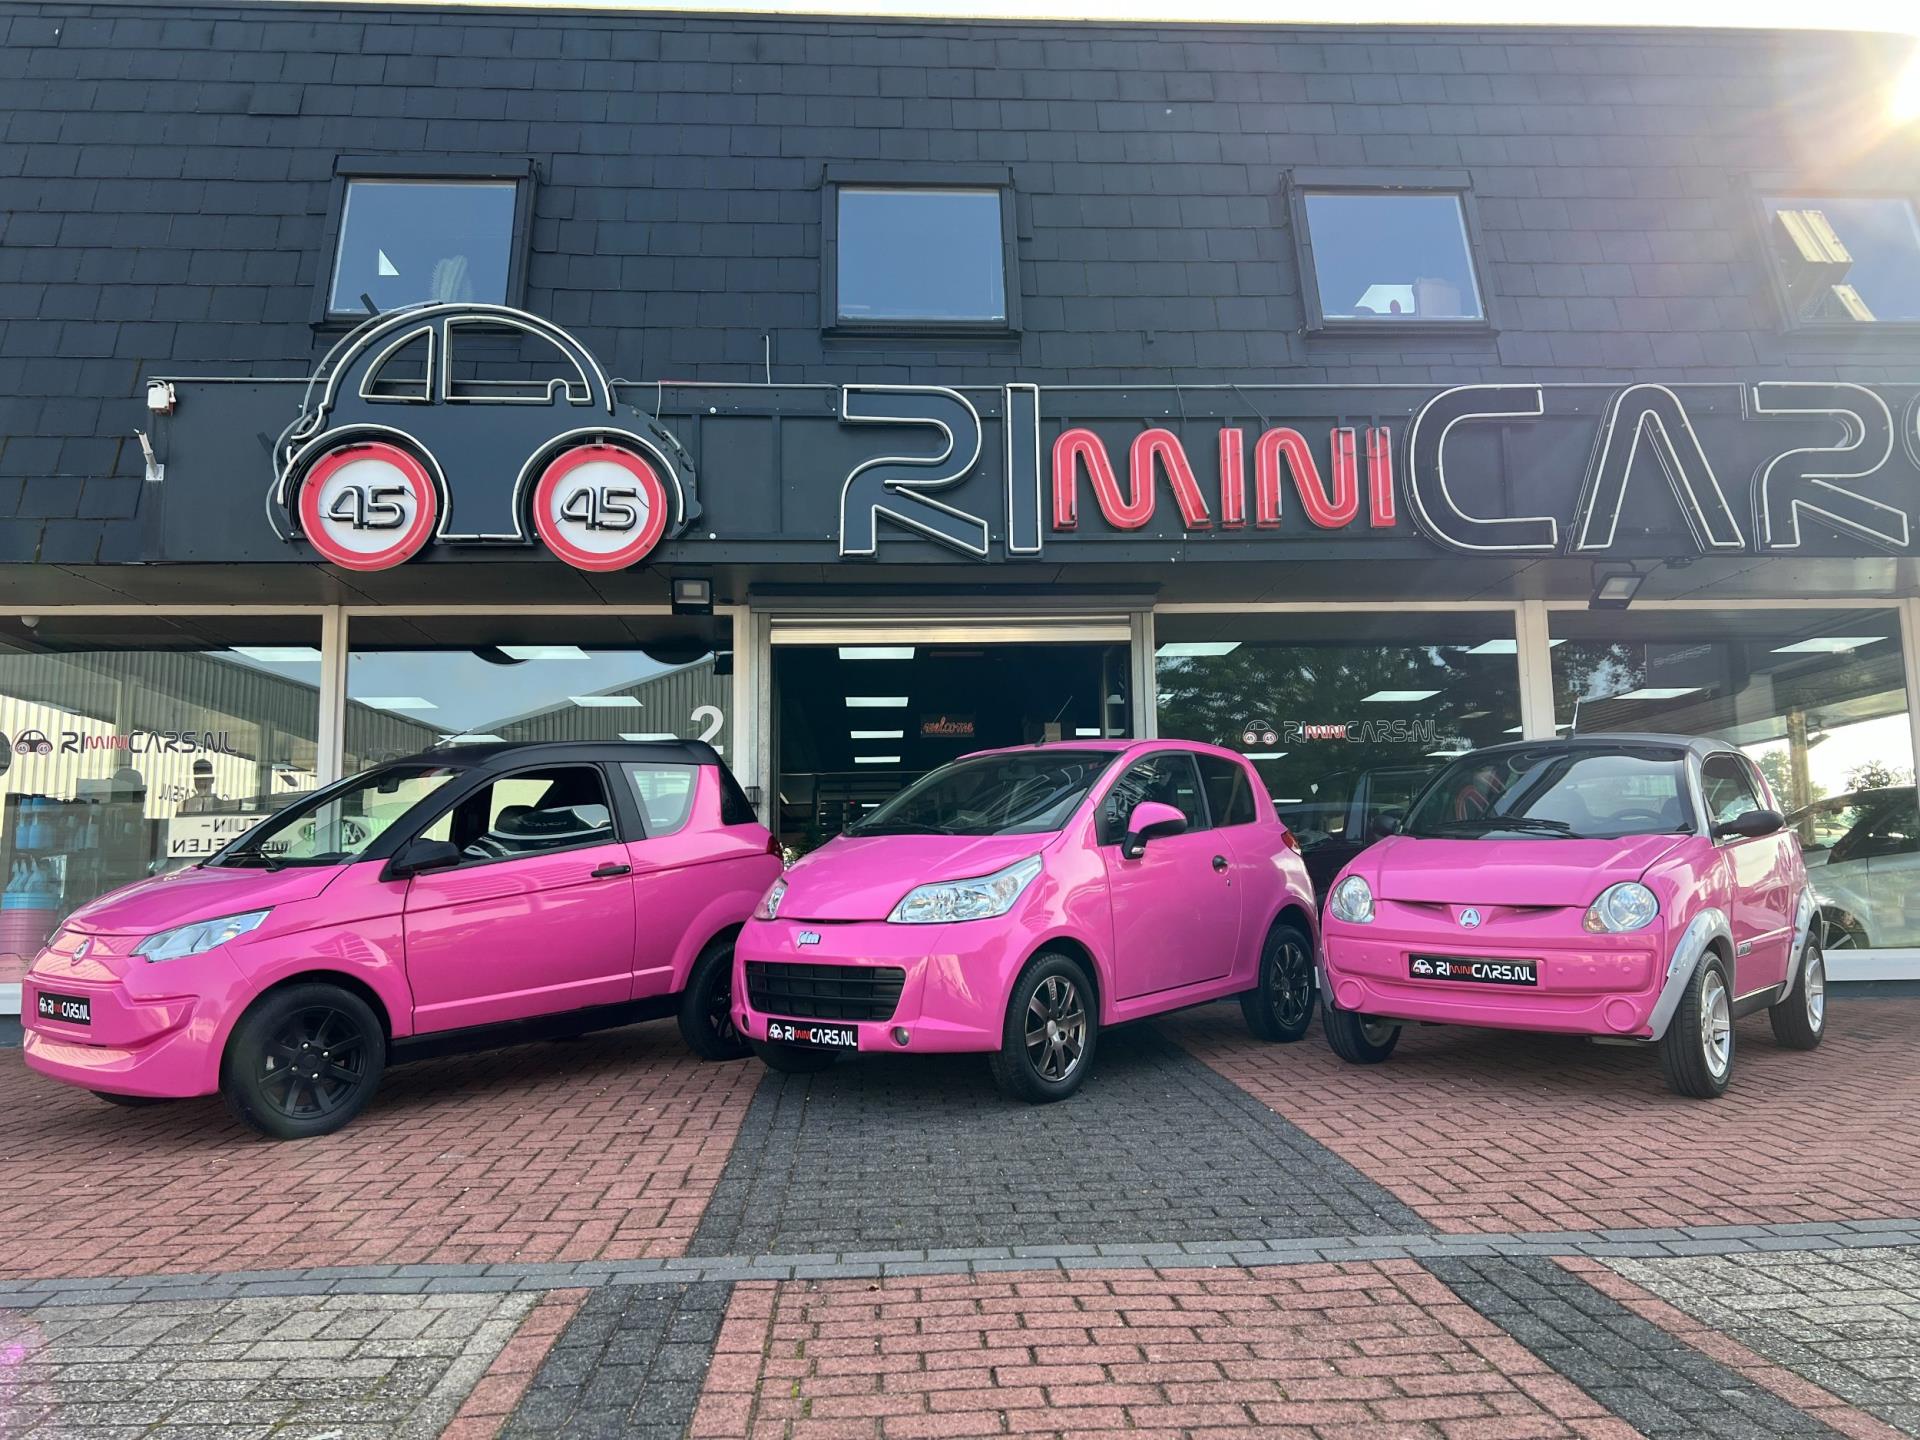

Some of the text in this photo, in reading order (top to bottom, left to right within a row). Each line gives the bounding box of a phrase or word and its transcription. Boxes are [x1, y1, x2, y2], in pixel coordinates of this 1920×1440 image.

[327, 485, 405, 530] 45
[560, 486, 637, 530] 45
[690, 705, 723, 755] 2
